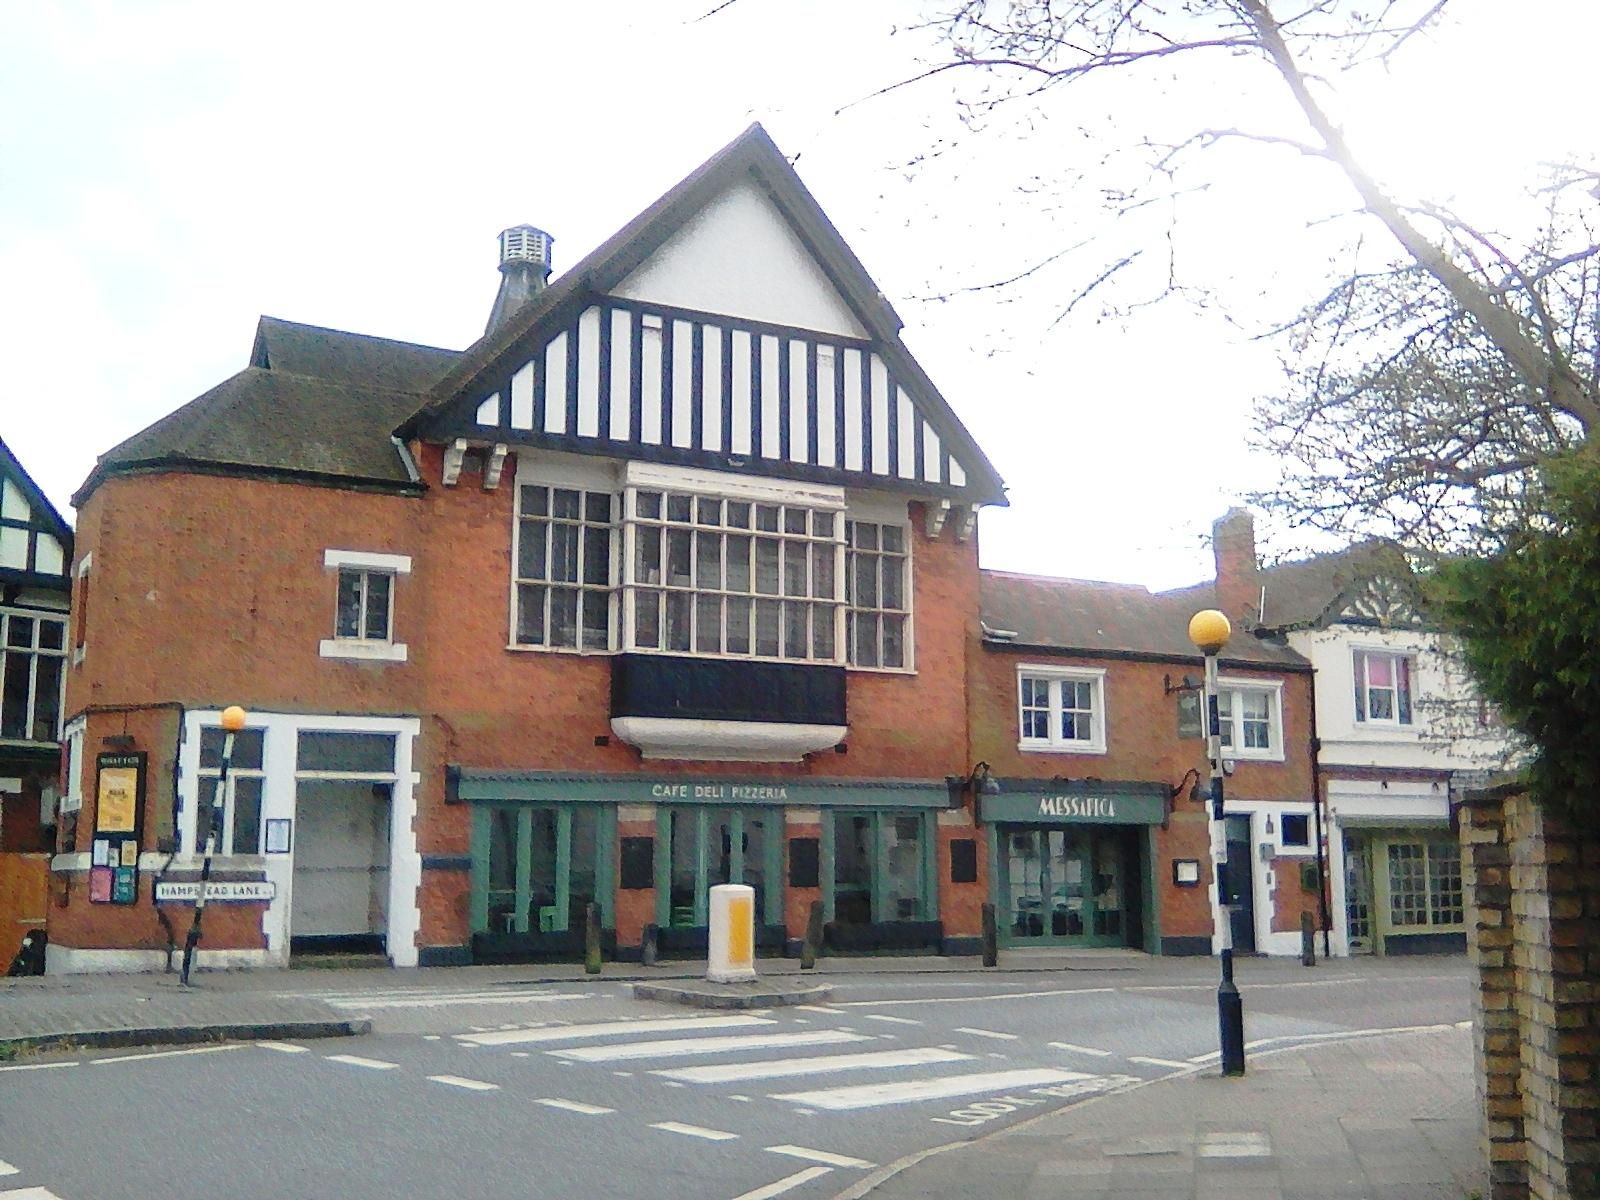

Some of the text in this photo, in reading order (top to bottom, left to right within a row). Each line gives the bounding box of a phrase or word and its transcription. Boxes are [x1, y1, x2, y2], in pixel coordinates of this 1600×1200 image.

[651, 783, 788, 799] CAFE DELI PIZZERIA
[161, 886, 229, 896] HAMPSEAD
[233, 886, 260, 896] LANE
[930, 1095, 1047, 1127] LOOK
